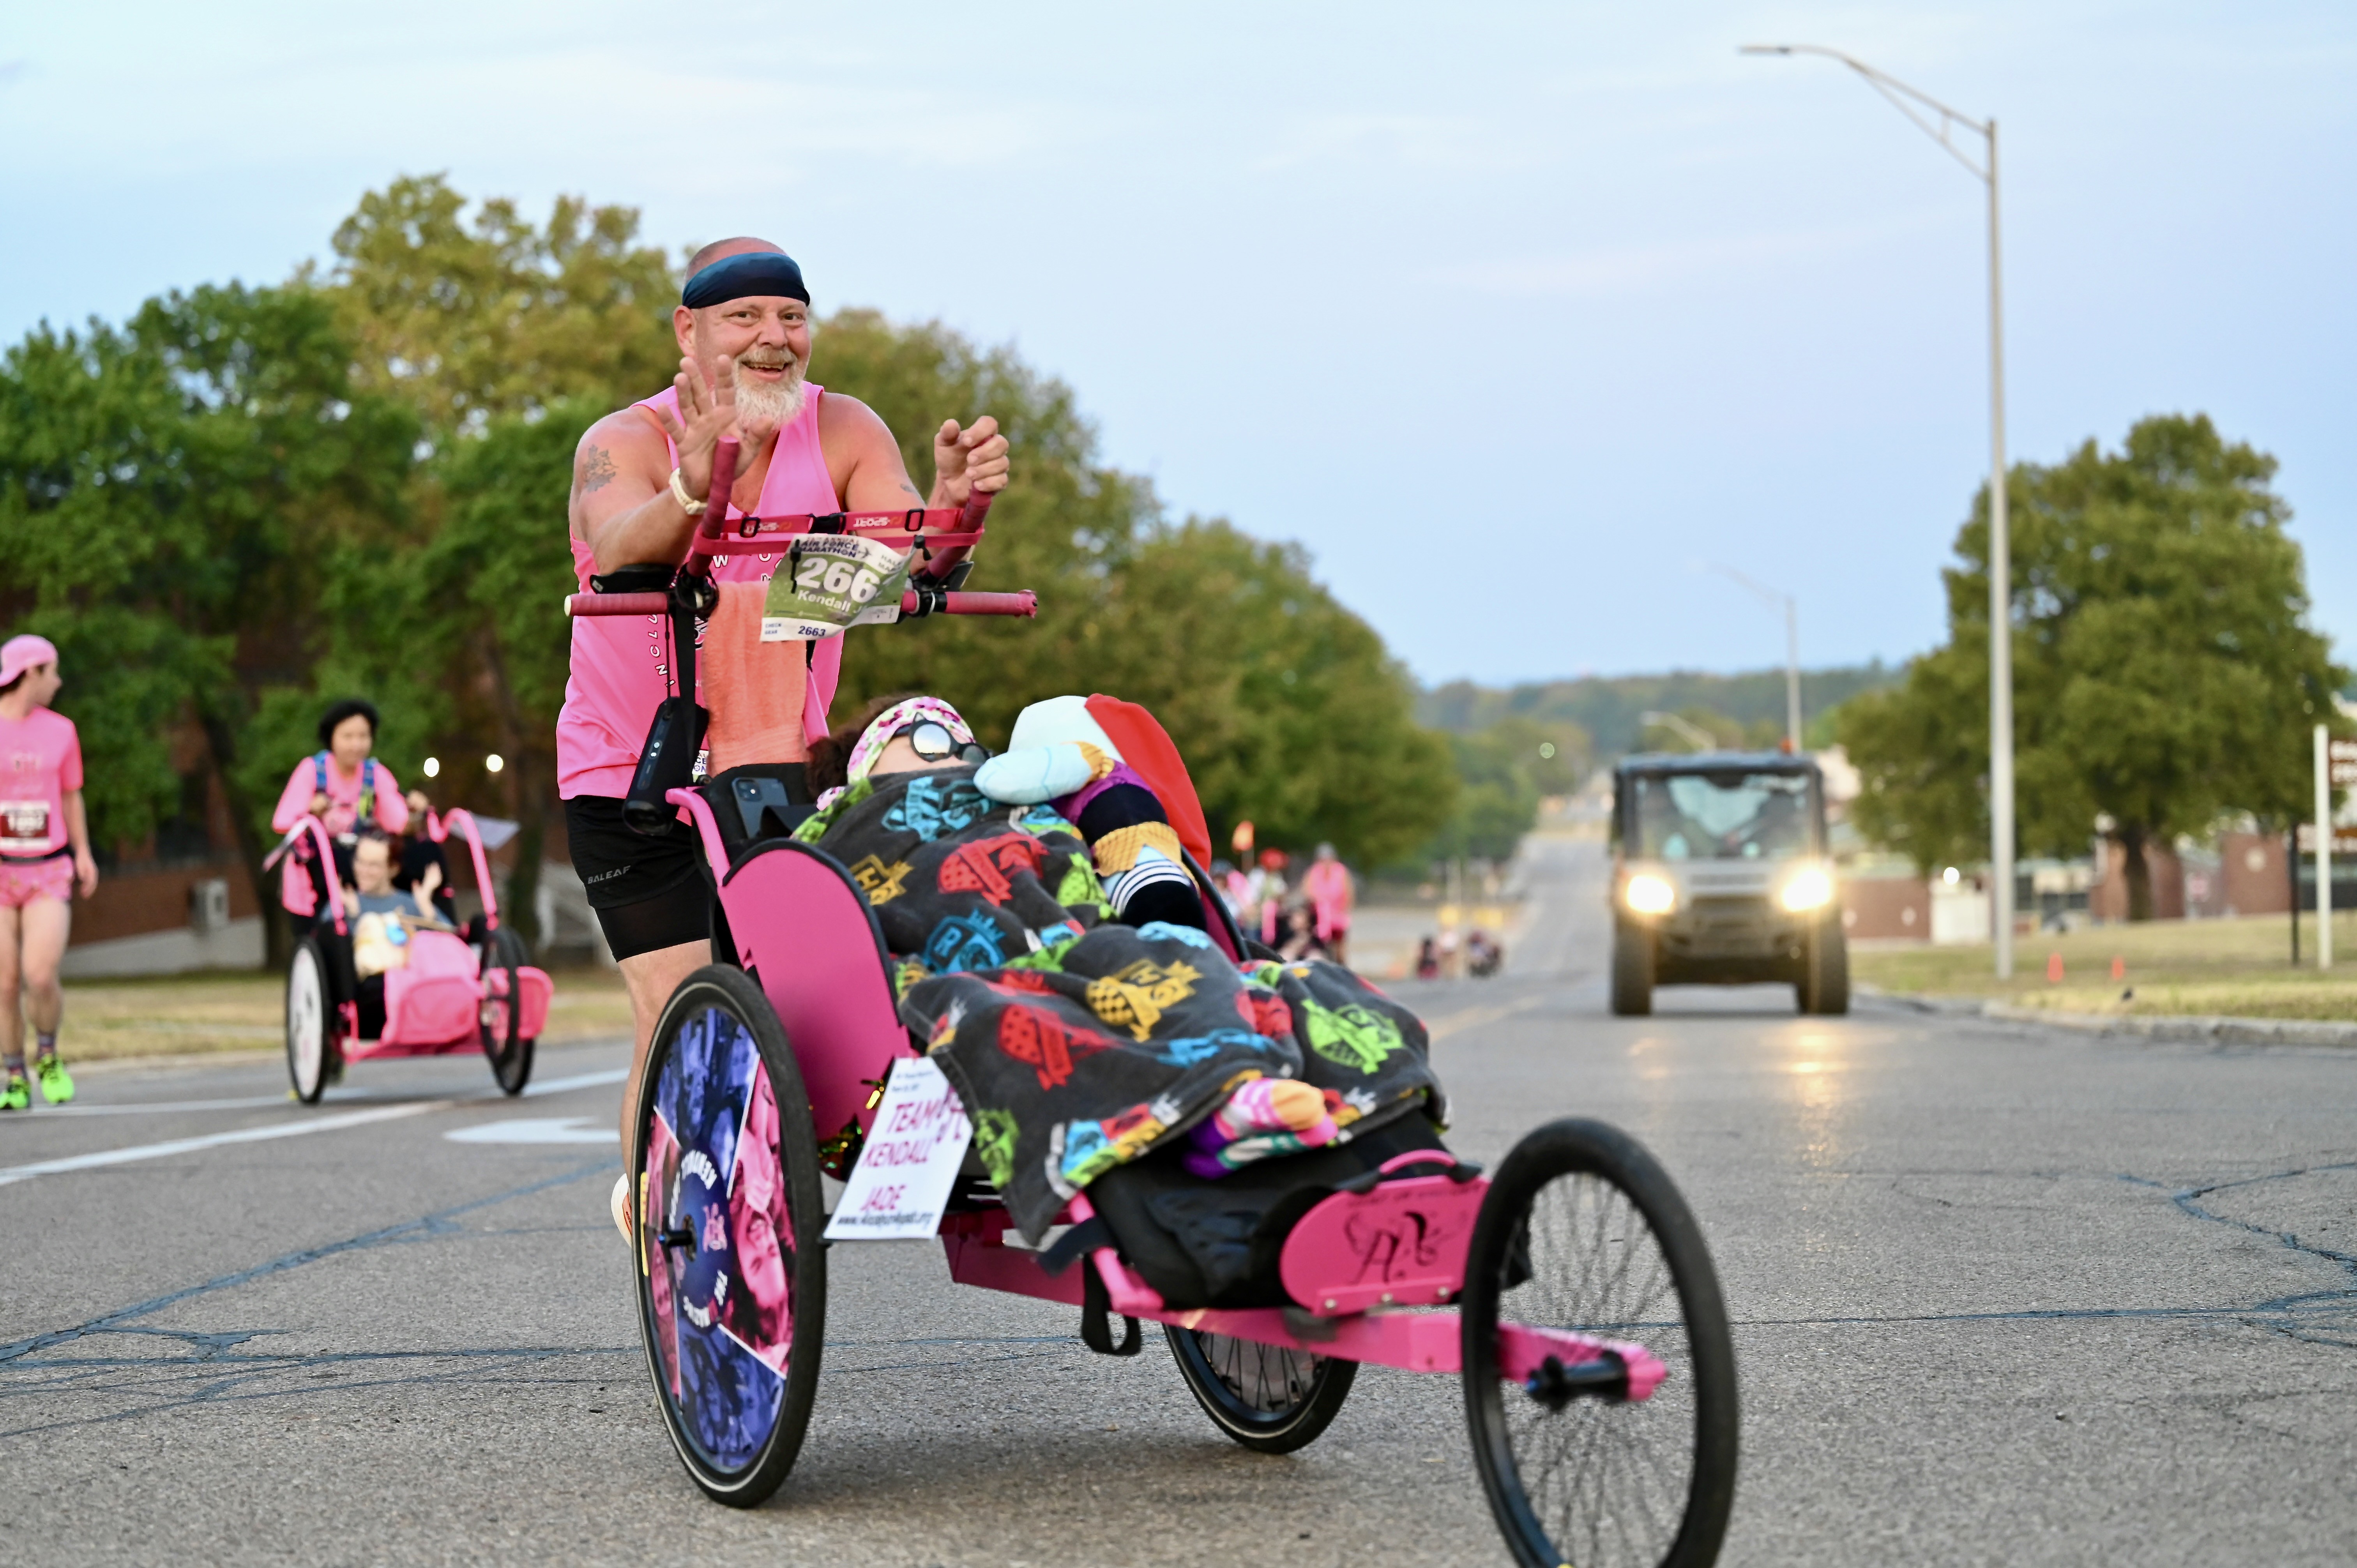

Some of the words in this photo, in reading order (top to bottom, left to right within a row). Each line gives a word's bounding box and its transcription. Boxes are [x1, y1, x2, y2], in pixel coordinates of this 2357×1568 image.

[801, 546, 856, 558] MARATHON
[822, 541, 860, 551] FORCE
[795, 557, 881, 603] 266
[797, 590, 851, 613] Kendall
[798, 625, 826, 637] 2663
[588, 865, 631, 885] BALEAF
[886, 1098, 942, 1133] TEAM
[861, 1139, 933, 1167] KENDALL
[860, 1185, 907, 1211] JADE
